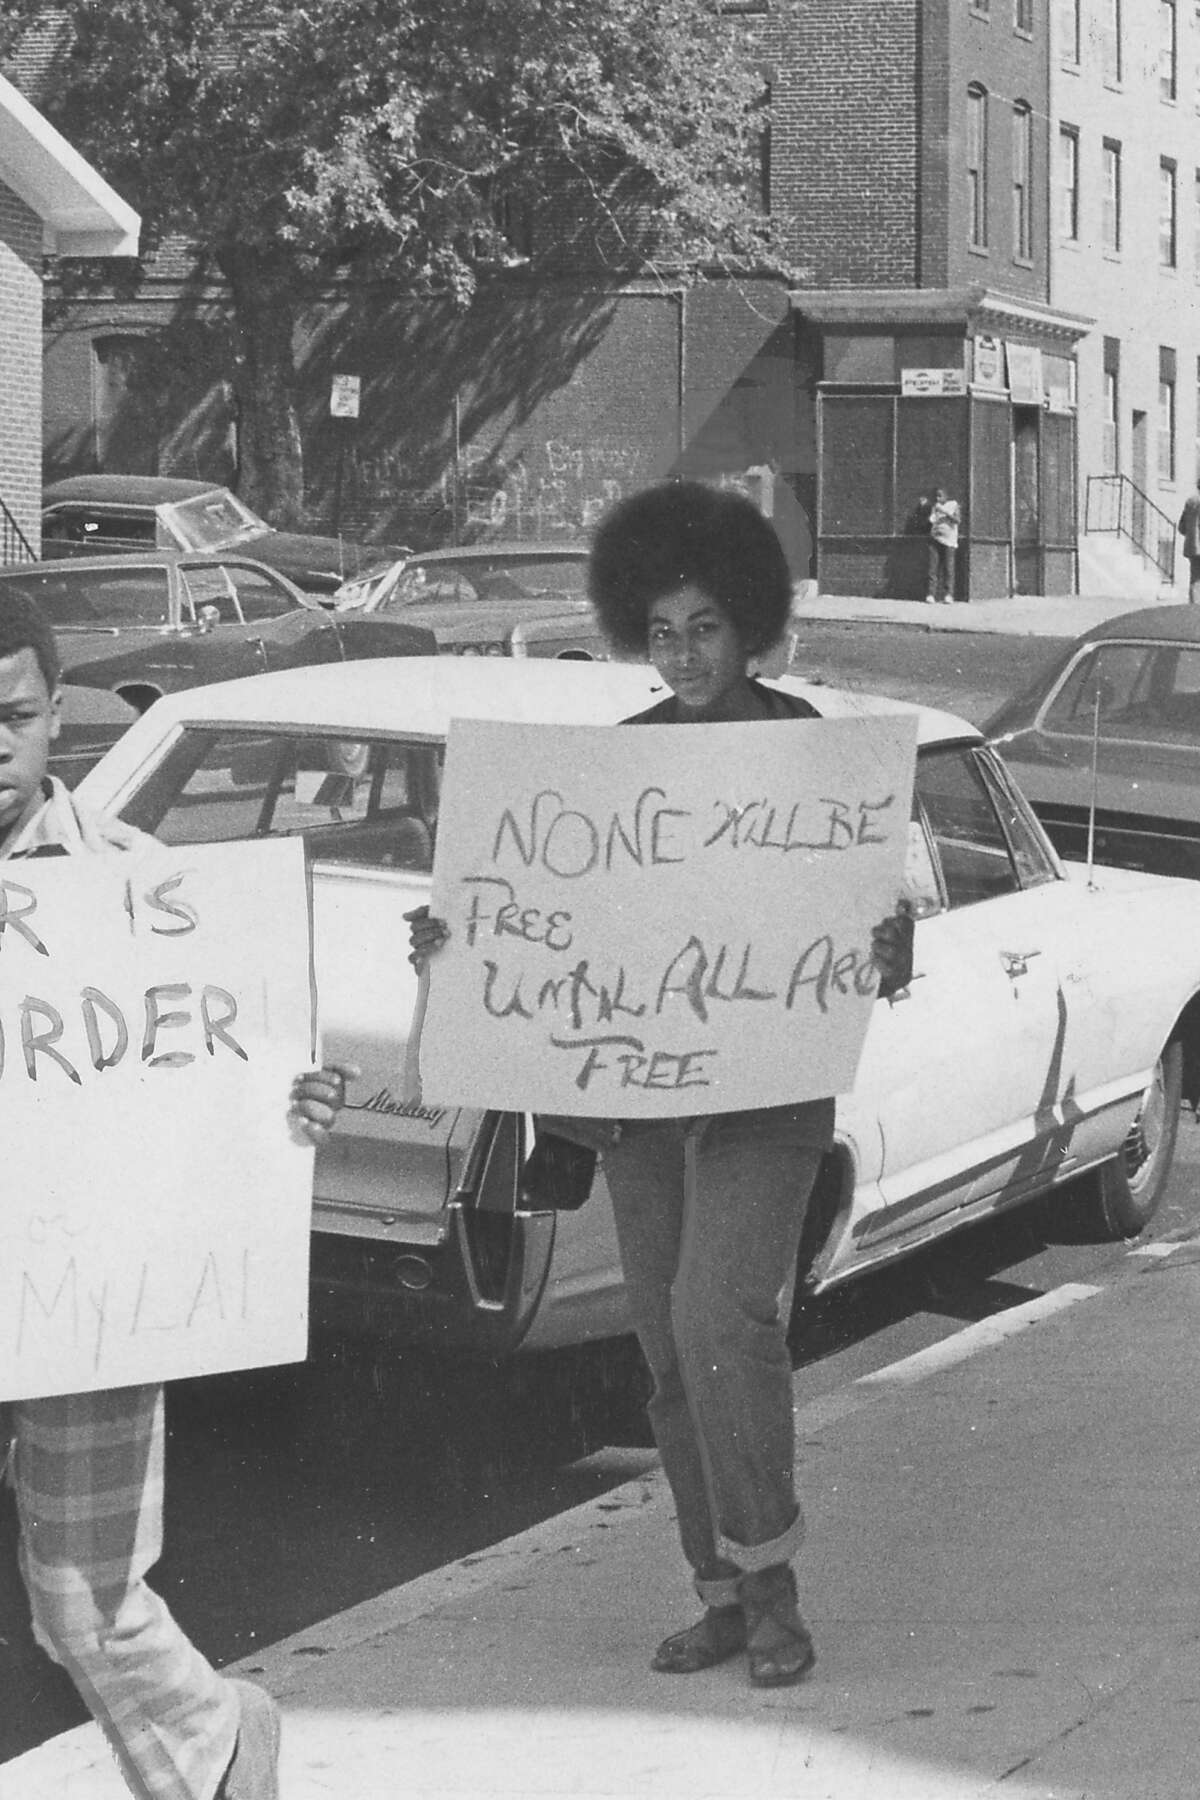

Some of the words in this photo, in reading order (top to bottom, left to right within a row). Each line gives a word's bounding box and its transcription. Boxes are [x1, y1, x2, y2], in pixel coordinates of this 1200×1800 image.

[493, 786, 693, 878] NONE
[818, 794, 896, 851] BE
[124, 870, 198, 937] IS
[462, 876, 573, 951] FREE
[656, 935, 778, 1024] ALL
[0, 983, 249, 1086] RDER
[550, 1033, 719, 1090] FREE
